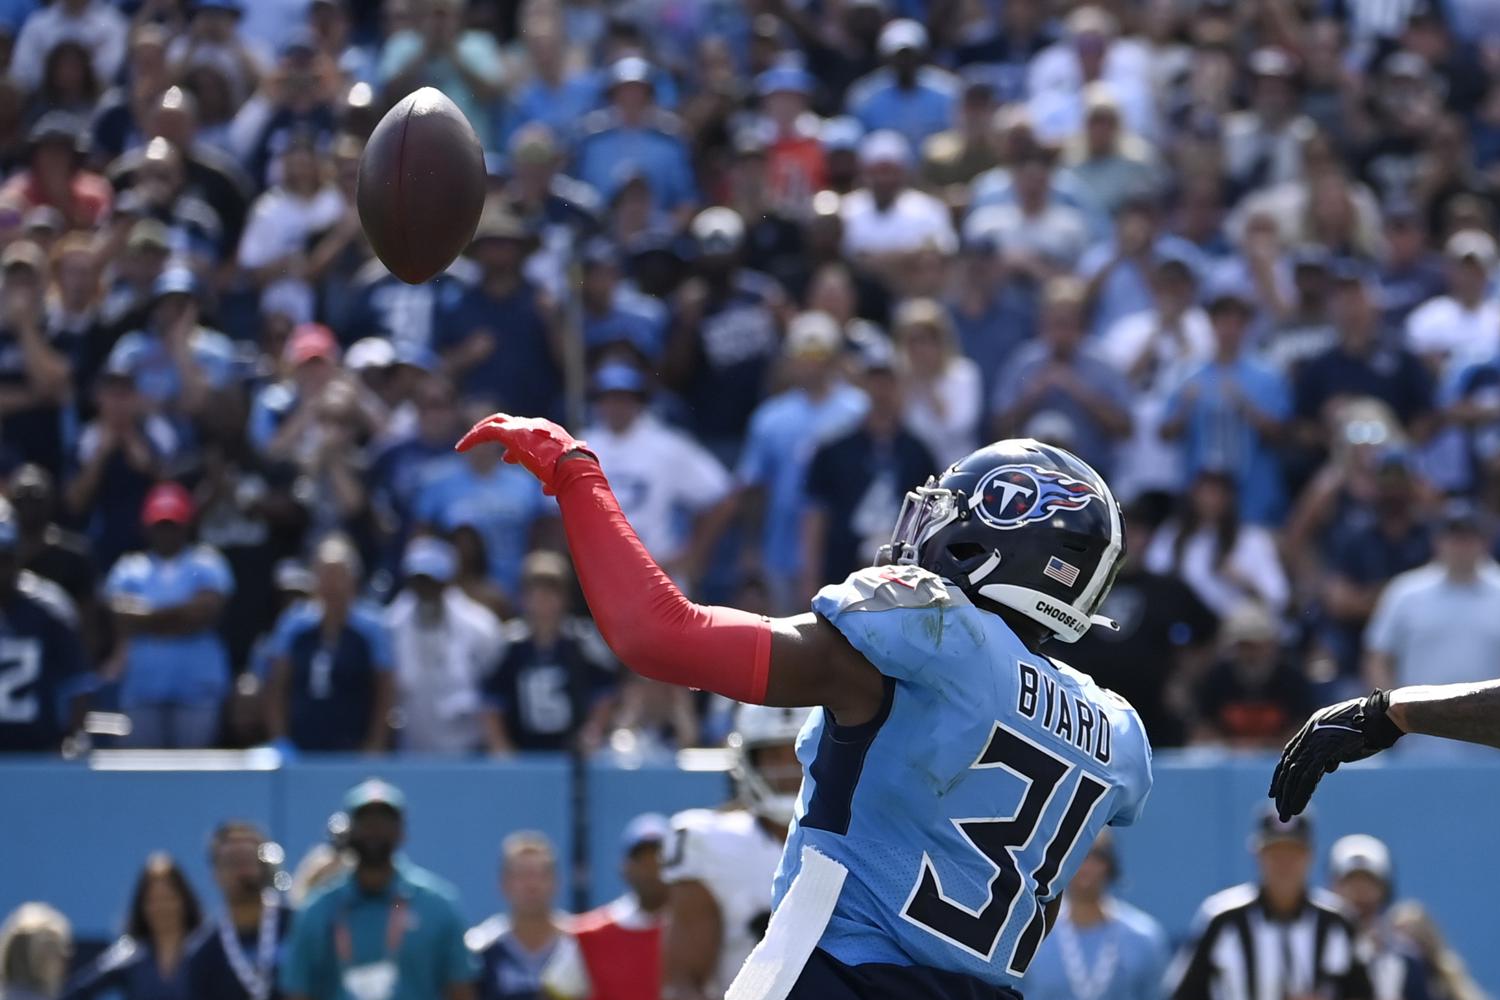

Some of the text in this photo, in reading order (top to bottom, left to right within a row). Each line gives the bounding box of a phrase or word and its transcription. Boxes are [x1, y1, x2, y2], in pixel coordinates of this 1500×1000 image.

[1035, 601, 1078, 631] CHOOSE
[1017, 660, 1113, 767] BYARD
[899, 720, 1112, 978] 31
